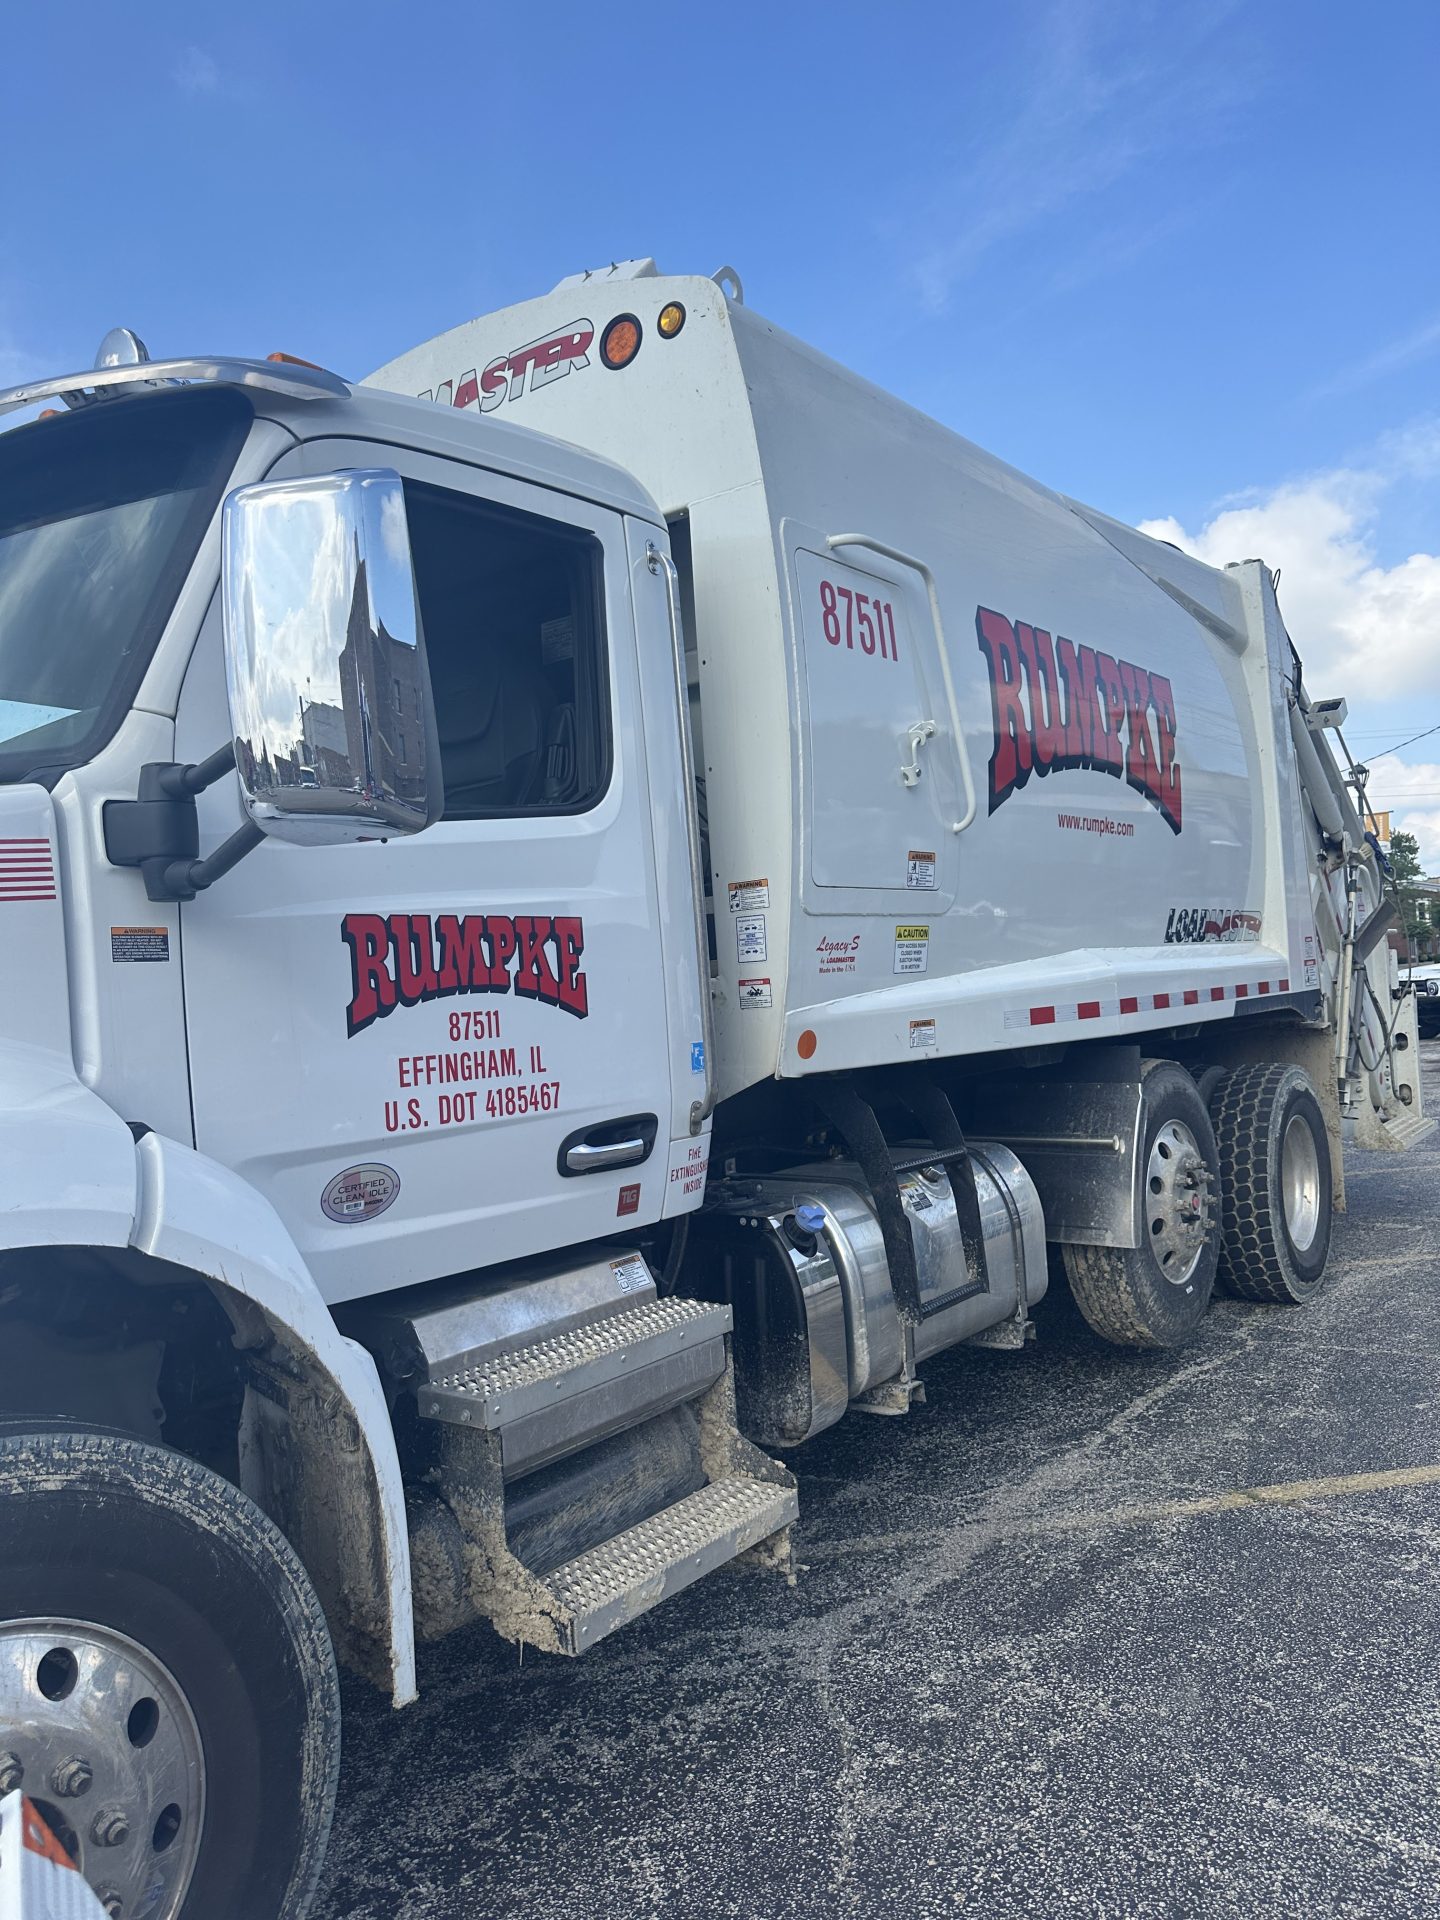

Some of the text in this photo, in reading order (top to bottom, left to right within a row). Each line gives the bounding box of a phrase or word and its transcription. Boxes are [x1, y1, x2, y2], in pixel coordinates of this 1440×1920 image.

[819, 580, 898, 662] 87511
[975, 605, 1182, 836] RUMPKE
[1057, 813, 1134, 837] www.rumpke.com
[738, 879, 763, 889] WARNING
[902, 928, 928, 938] CAUTION
[1164, 908, 1262, 943] LOADMASTER
[816, 935, 860, 956] Legacy-S
[340, 913, 589, 1039] RUMPKE
[448, 1009, 501, 1041] 87511
[399, 1045, 547, 1088] EFFINGHAM, IL
[385, 1081, 561, 1132] U.S. DOT 4185467
[688, 1146, 702, 1161] FIRE
[670, 1159, 708, 1182] EXTINGUISH
[332, 1192, 365, 1205] CLEAN
[369, 1187, 390, 1197] IDLE
[337, 1178, 386, 1194] CERTIFIED
[682, 1176, 703, 1195] INSIDE
